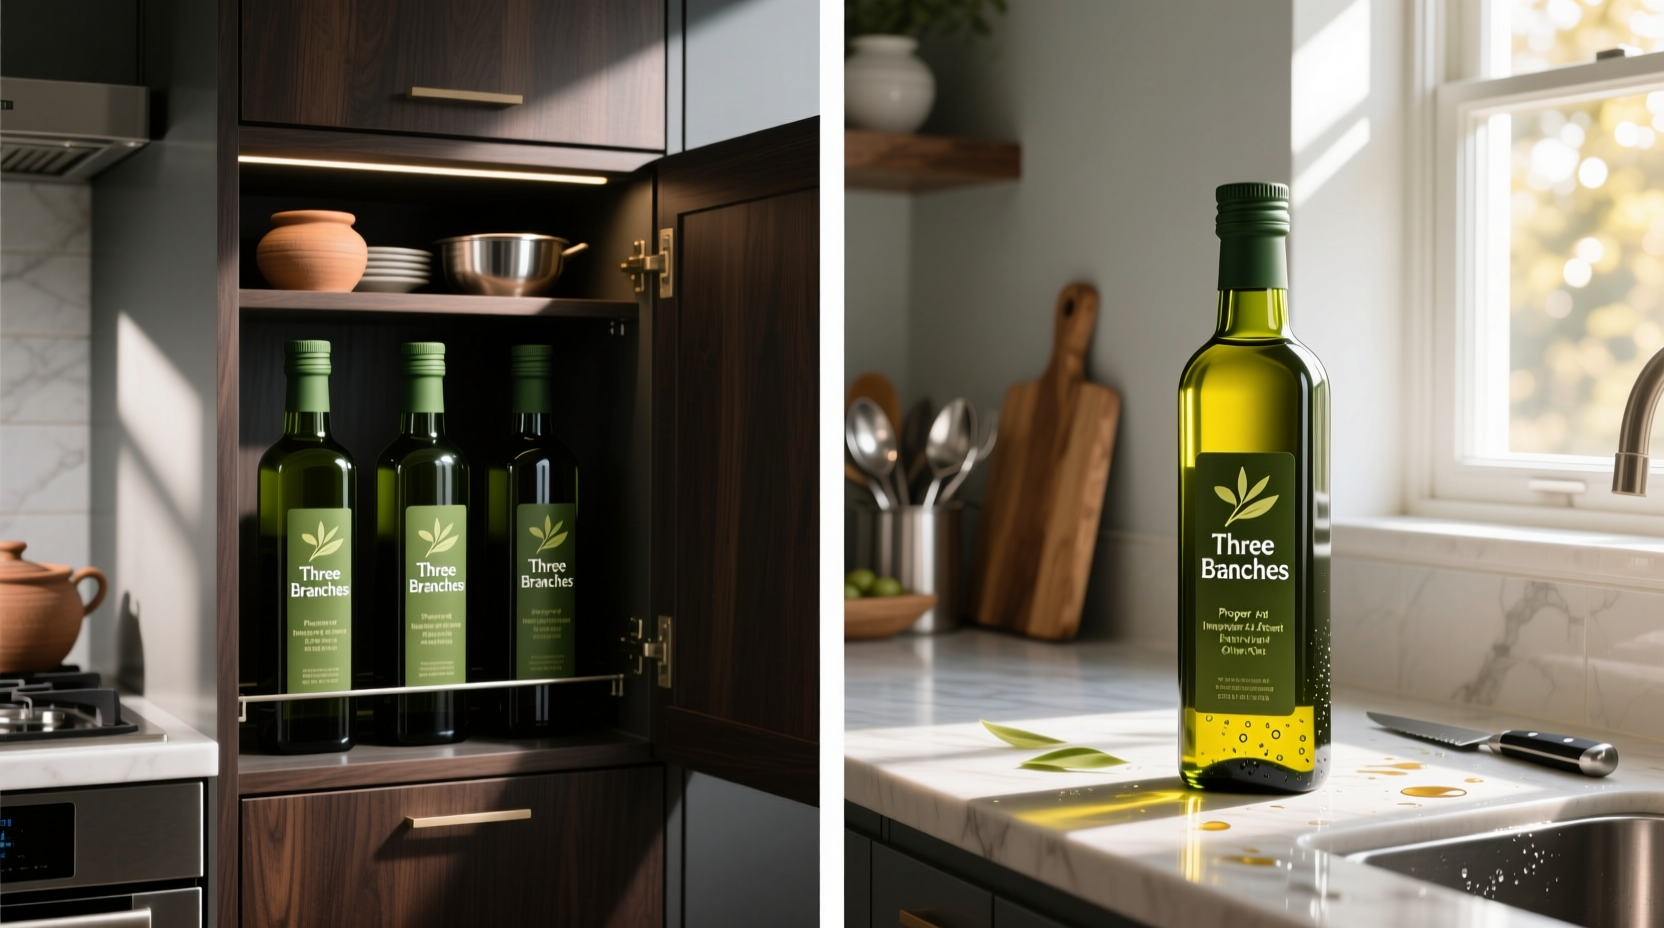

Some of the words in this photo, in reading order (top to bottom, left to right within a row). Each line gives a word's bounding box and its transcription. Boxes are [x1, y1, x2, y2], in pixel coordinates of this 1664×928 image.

[1211, 532, 1275, 556] Three
[298, 565, 341, 581] Three
[416, 561, 457, 577] Three
[527, 557, 567, 573] Three
[521, 573, 574, 588] Branches
[290, 581, 349, 597] Branches
